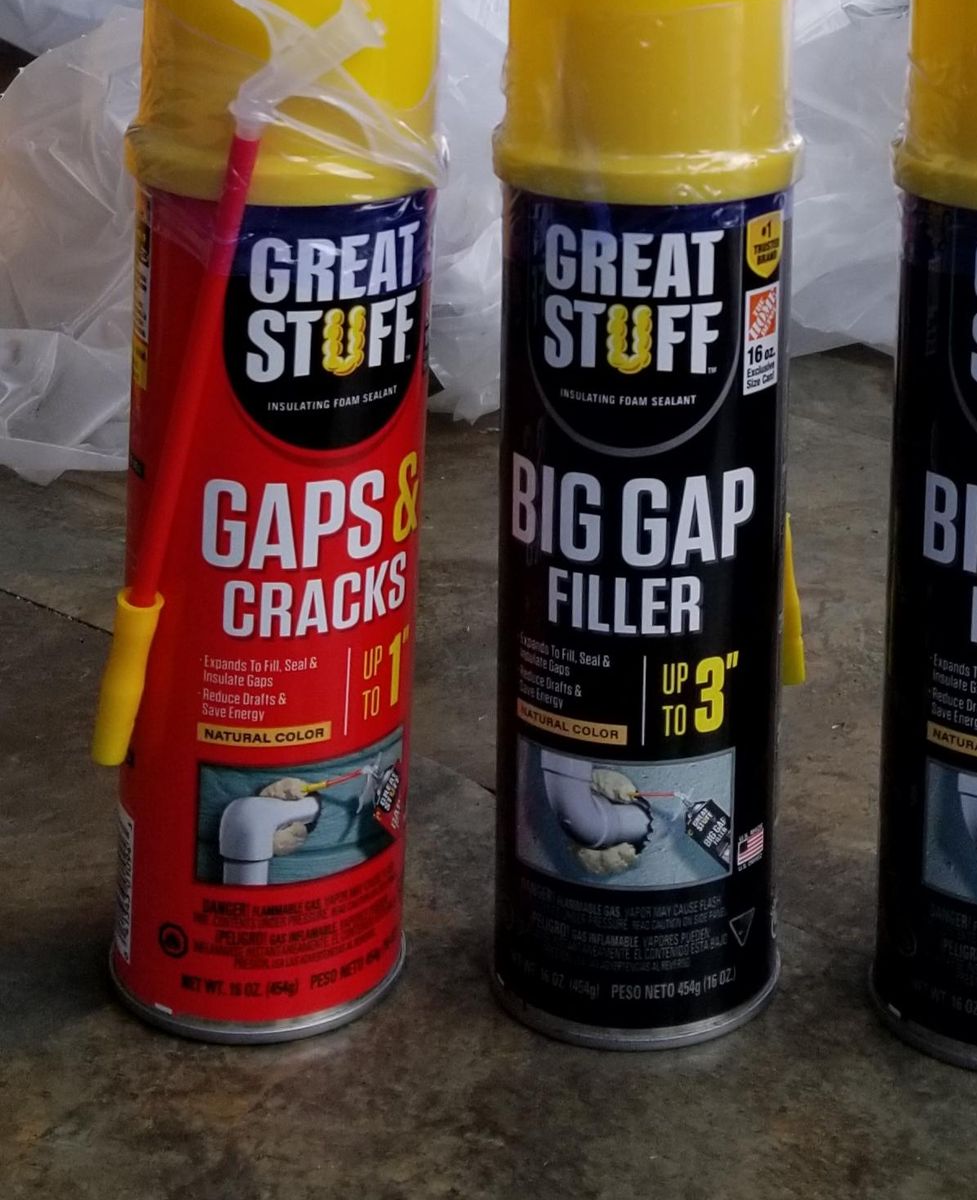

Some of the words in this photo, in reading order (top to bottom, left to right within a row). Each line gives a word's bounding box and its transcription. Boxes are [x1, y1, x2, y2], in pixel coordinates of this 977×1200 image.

[762, 221, 771, 238] #1
[250, 221, 420, 303] GREAT
[545, 224, 724, 298] GREAT
[246, 291, 416, 383] STUFF
[543, 294, 723, 374] STUFF
[747, 344, 762, 365] 16
[764, 347, 776, 360] oz.
[746, 361, 775, 379] Exclusive
[746, 375, 760, 389] Size
[267, 399, 330, 412] INSULATING
[333, 395, 360, 409] FOAM
[362, 384, 398, 405] SEALANT
[560, 388, 615, 404] INSULATING
[619, 395, 647, 406] FOAM
[651, 394, 696, 406] SEALANT
[201, 469, 385, 569] GAPS
[392, 451, 420, 543] &
[512, 451, 601, 563] BIG
[621, 466, 755, 568] GAP
[222, 551, 406, 637] CRACKS
[548, 566, 702, 635] FILLER
[204, 654, 247, 672] Expands
[250, 657, 262, 672] To
[284, 657, 308, 672] Seal
[309, 656, 318, 670] &
[363, 645, 382, 680] UP
[548, 659, 570, 677] Gaps
[551, 644, 560, 659] To
[579, 651, 600, 667] Seal
[602, 655, 611, 668] &
[933, 652, 970, 677] Expands
[203, 671, 244, 686] Insulate
[246, 674, 274, 689] Gaps
[546, 677, 572, 696] Drafts
[574, 684, 582, 697] &
[662, 662, 688, 695] UP
[932, 668, 968, 692] Insulate
[202, 689, 241, 704] Reduce
[242, 691, 276, 706] Drafts
[277, 692, 287, 705] &
[362, 686, 380, 720] TO
[536, 687, 564, 710] Energy
[202, 703, 226, 718] Save
[228, 705, 265, 722] Energy
[520, 704, 569, 732] NATURAL
[572, 724, 618, 740] COLOR
[662, 704, 687, 736] TO
[931, 701, 952, 721] Save
[204, 727, 276, 743] NATURAL
[278, 727, 325, 742] COLOR
[703, 830, 717, 848] BIG
[611, 984, 641, 1000] PESO
[644, 982, 675, 1000] NETO
[677, 979, 701, 997] 454g
[703, 973, 717, 991] (16
